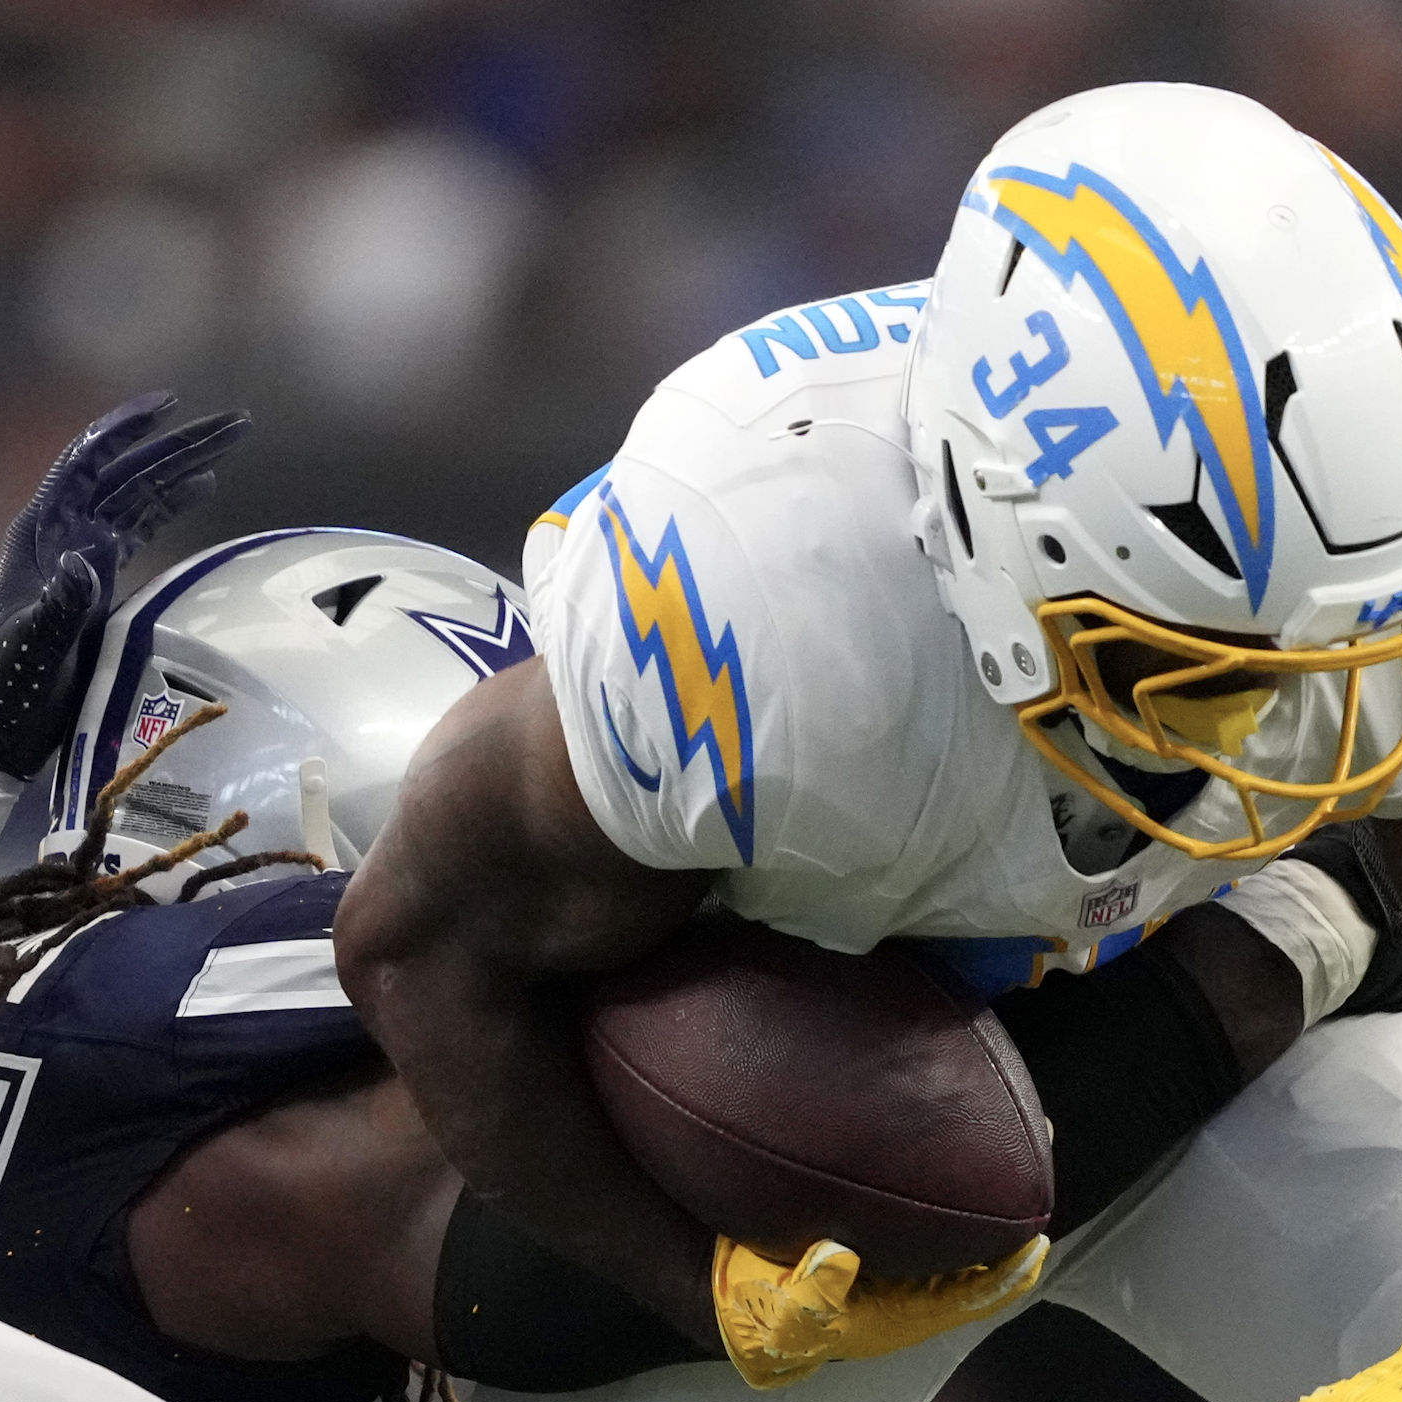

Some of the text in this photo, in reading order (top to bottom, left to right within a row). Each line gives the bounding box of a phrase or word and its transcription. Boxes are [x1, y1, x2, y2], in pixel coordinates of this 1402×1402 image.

[972, 310, 1121, 487] 34
[136, 716, 167, 744] NFL
[1091, 901, 1130, 924] NFL
